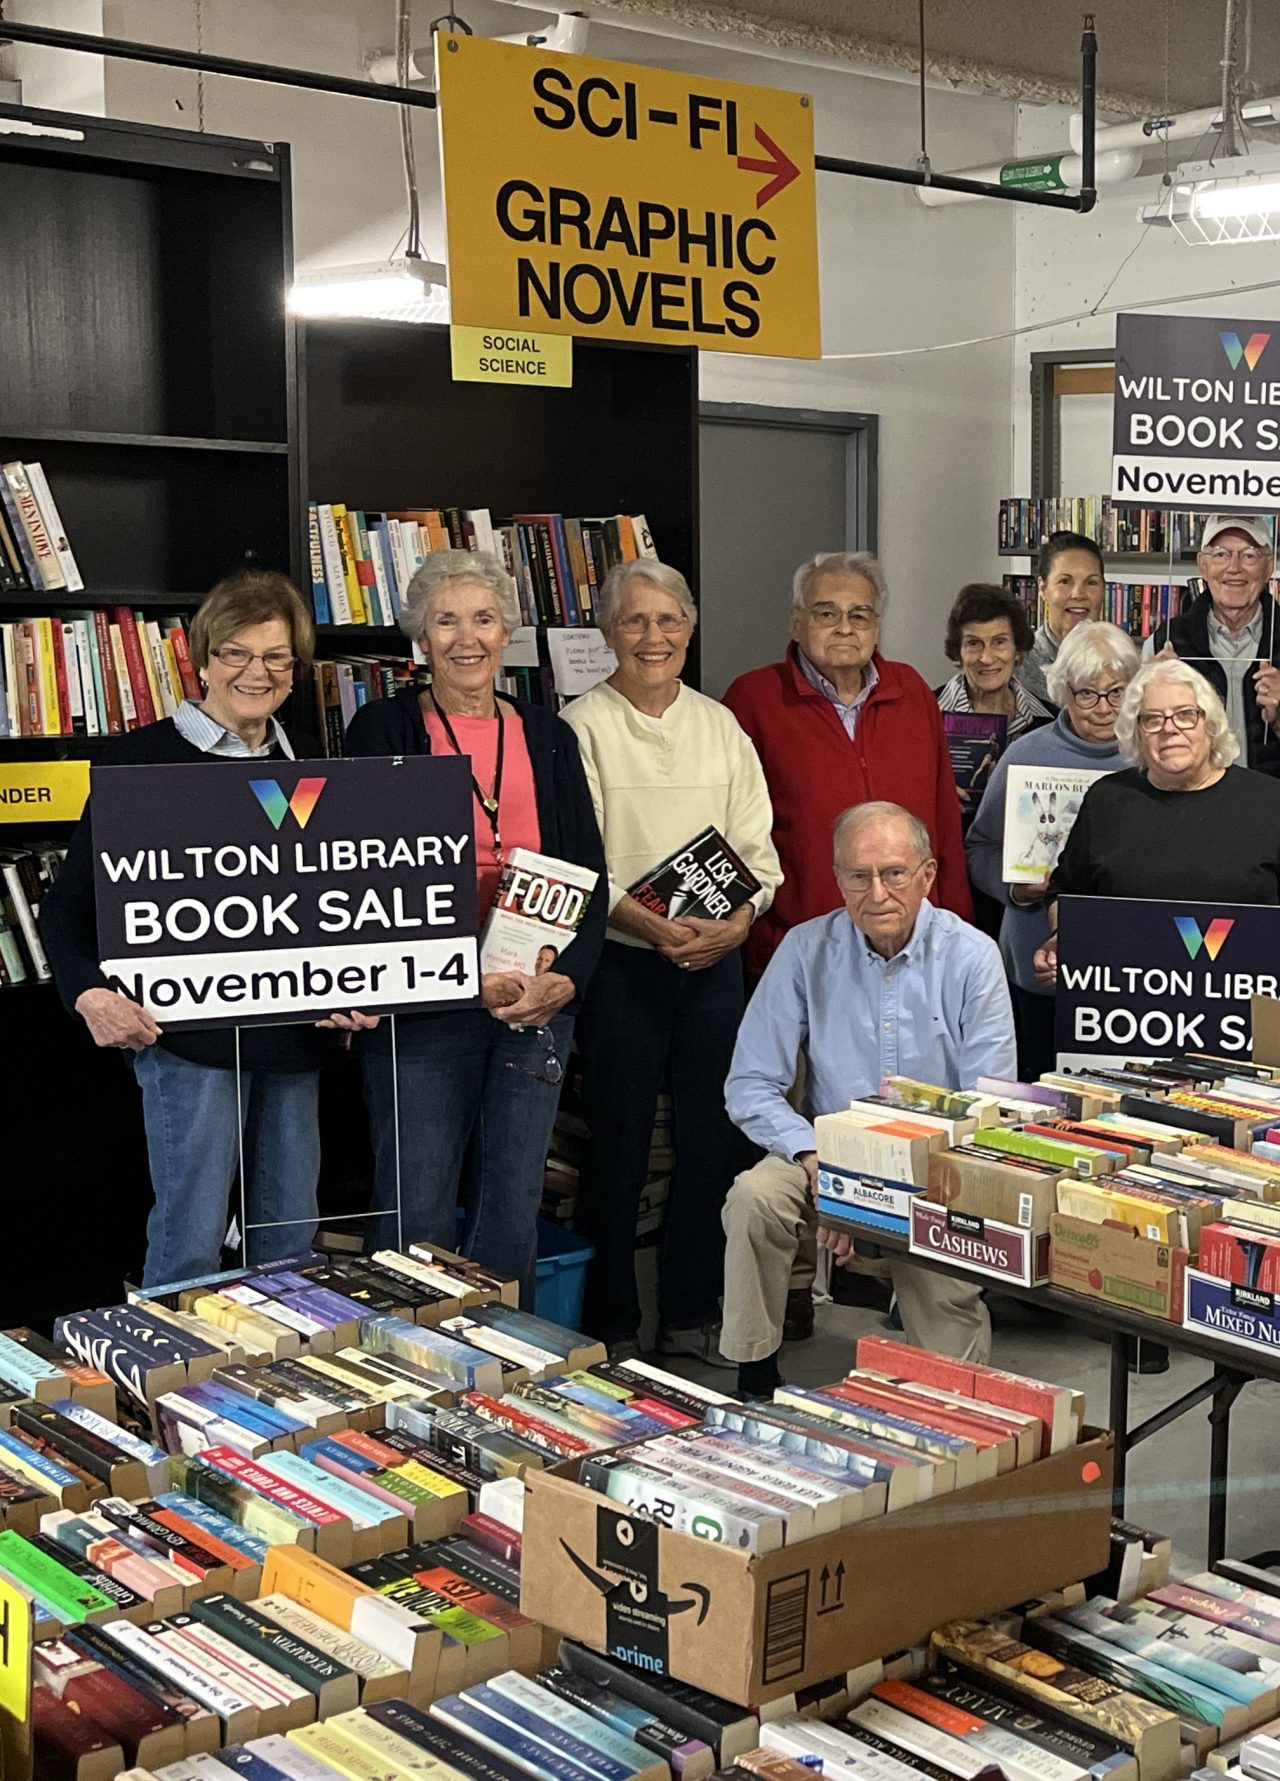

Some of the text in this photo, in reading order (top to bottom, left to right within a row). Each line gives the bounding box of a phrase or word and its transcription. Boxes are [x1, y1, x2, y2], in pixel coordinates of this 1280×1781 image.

[533, 68, 738, 156] SCI-FI
[496, 180, 776, 275] GRAPHIC
[517, 258, 760, 338] NOVELS
[483, 336, 540, 353] SOCIAL
[479, 358, 546, 376] SCIENCE
[1119, 376, 1233, 403] WILTON
[1130, 414, 1243, 449] BOOK
[1025, 781, 1070, 792] MARLON
[100, 834, 469, 883] WILTON LIBRARY
[704, 851, 738, 889] LISA
[504, 870, 584, 926] FOOD
[673, 852, 731, 920] GARDNER
[124, 892, 299, 944] BOOK
[318, 884, 456, 932] SALE
[107, 952, 469, 1008] November 1-4
[1060, 963, 1194, 996] WILTON
[1074, 1006, 1206, 1049] BOOK
[853, 1187, 895, 1204] ALBACORE
[951, 1215, 980, 1229] KIRKLAND
[928, 1225, 1008, 1267] CASHEWS
[1235, 1288, 1270, 1306] KIRKLAND
[1205, 1304, 1255, 1336] MIXED
[432, 1412, 467, 1433] YARD
[240, 1467, 274, 1494] FURIES
[760, 1473, 826, 1500] ALEX GERLIS
[296, 1494, 329, 1521] FATES
[613, 1602, 631, 1614] video
[632, 1608, 666, 1628] streaming
[271, 1634, 323, 1668] GRAFTON
[616, 1645, 663, 1674] prime
[854, 1730, 920, 1768] STILL ALICE
[1054, 1727, 1096, 1751] GEORGE
